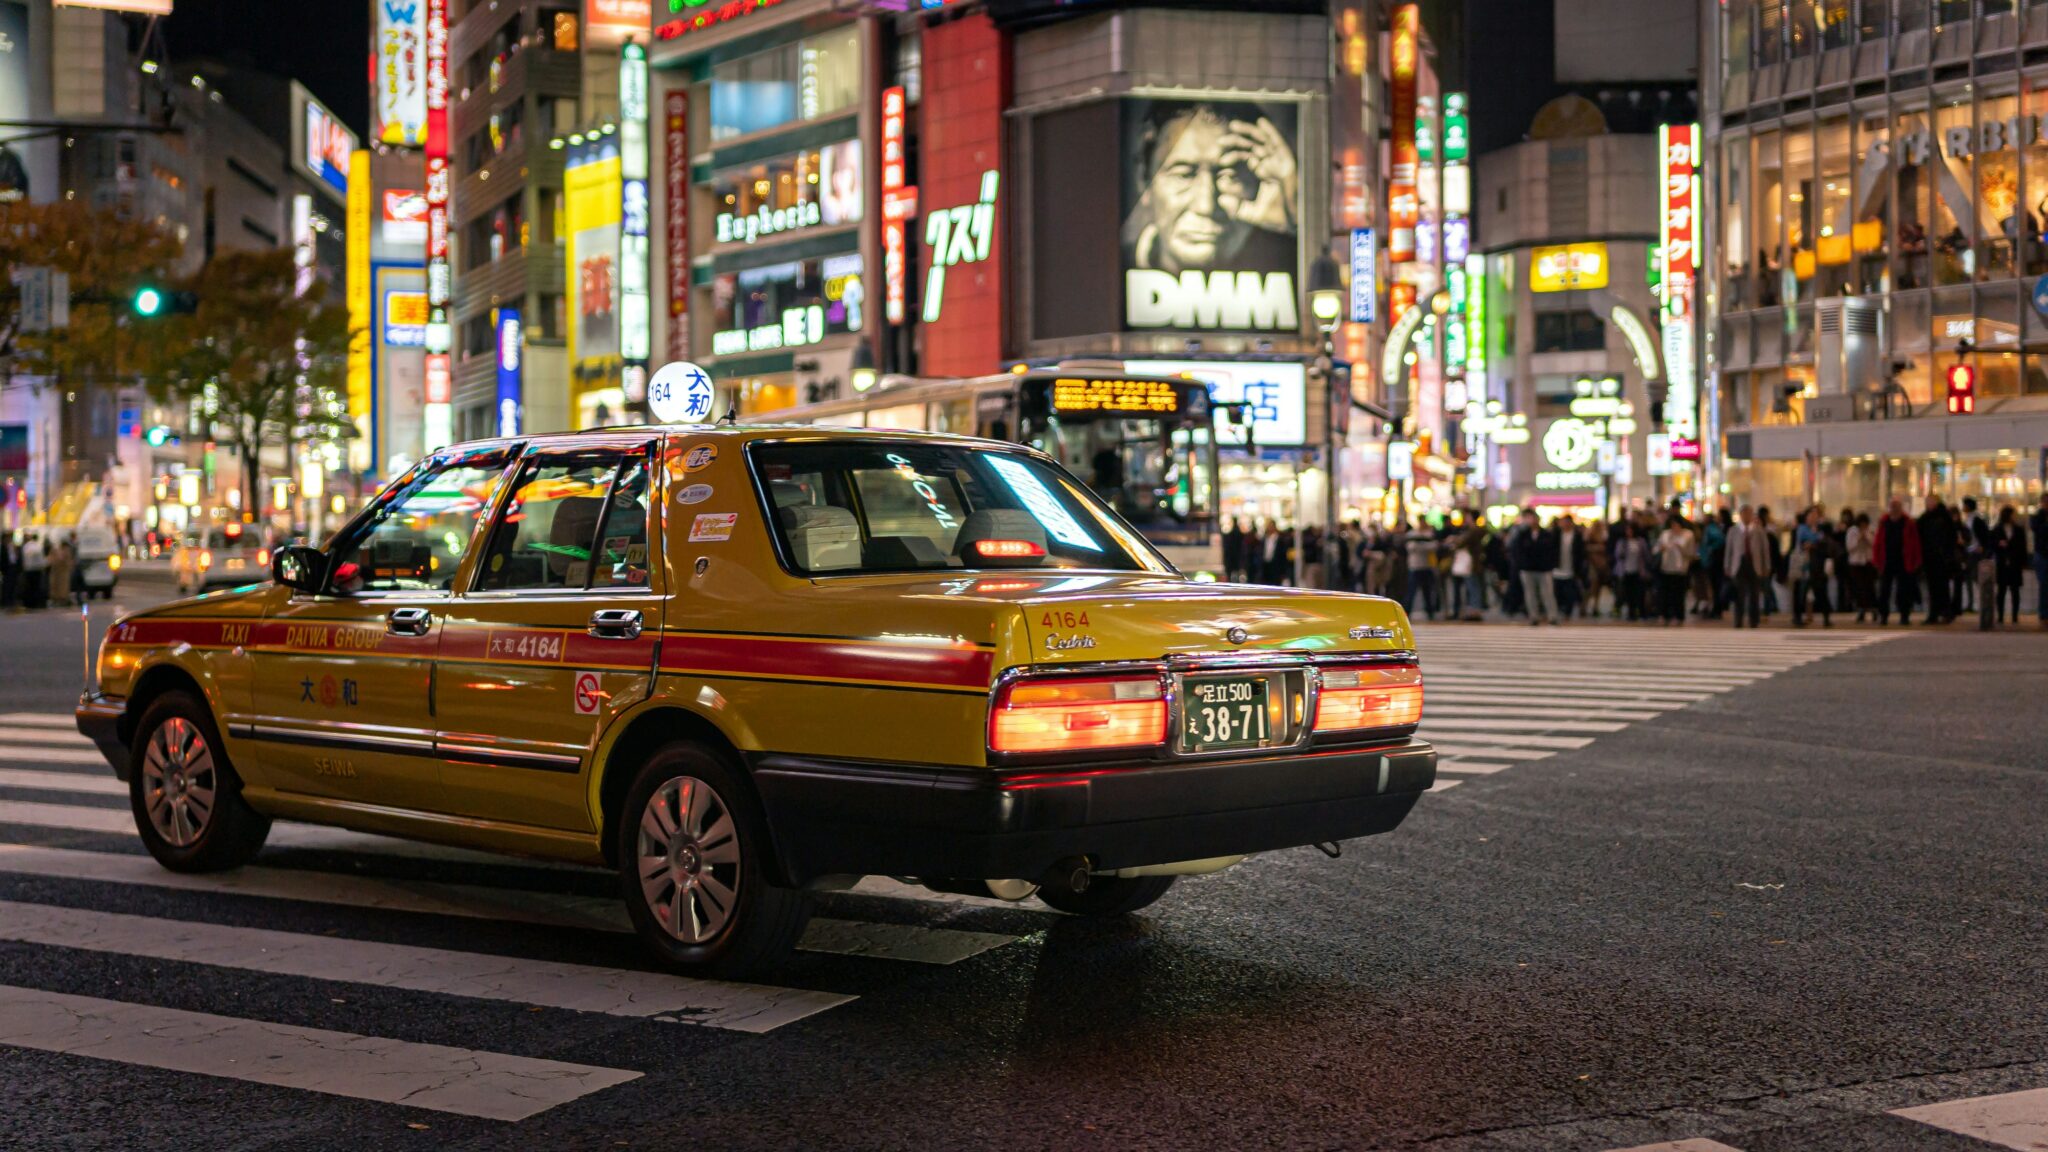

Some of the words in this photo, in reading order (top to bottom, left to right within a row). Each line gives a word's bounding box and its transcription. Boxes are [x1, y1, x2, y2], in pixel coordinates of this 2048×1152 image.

[1864, 112, 2048, 172] STARBU
[1668, 142, 1692, 262] カラオケ
[716, 202, 820, 244] Euphoria
[922, 169, 1000, 323] クスリ
[1126, 268, 1298, 330] DMM
[648, 382, 671, 402] 164
[685, 369, 710, 416] 大和
[221, 624, 250, 643] TAXI
[1042, 611, 1090, 628] 4164
[286, 626, 328, 647] DAIWA
[334, 628, 385, 649] GROUP
[491, 638, 514, 653] 大和
[517, 636, 560, 658] 4164
[1188, 718, 1199, 735] え
[1201, 704, 1265, 742] 38-71
[315, 757, 357, 778] SEIWA
